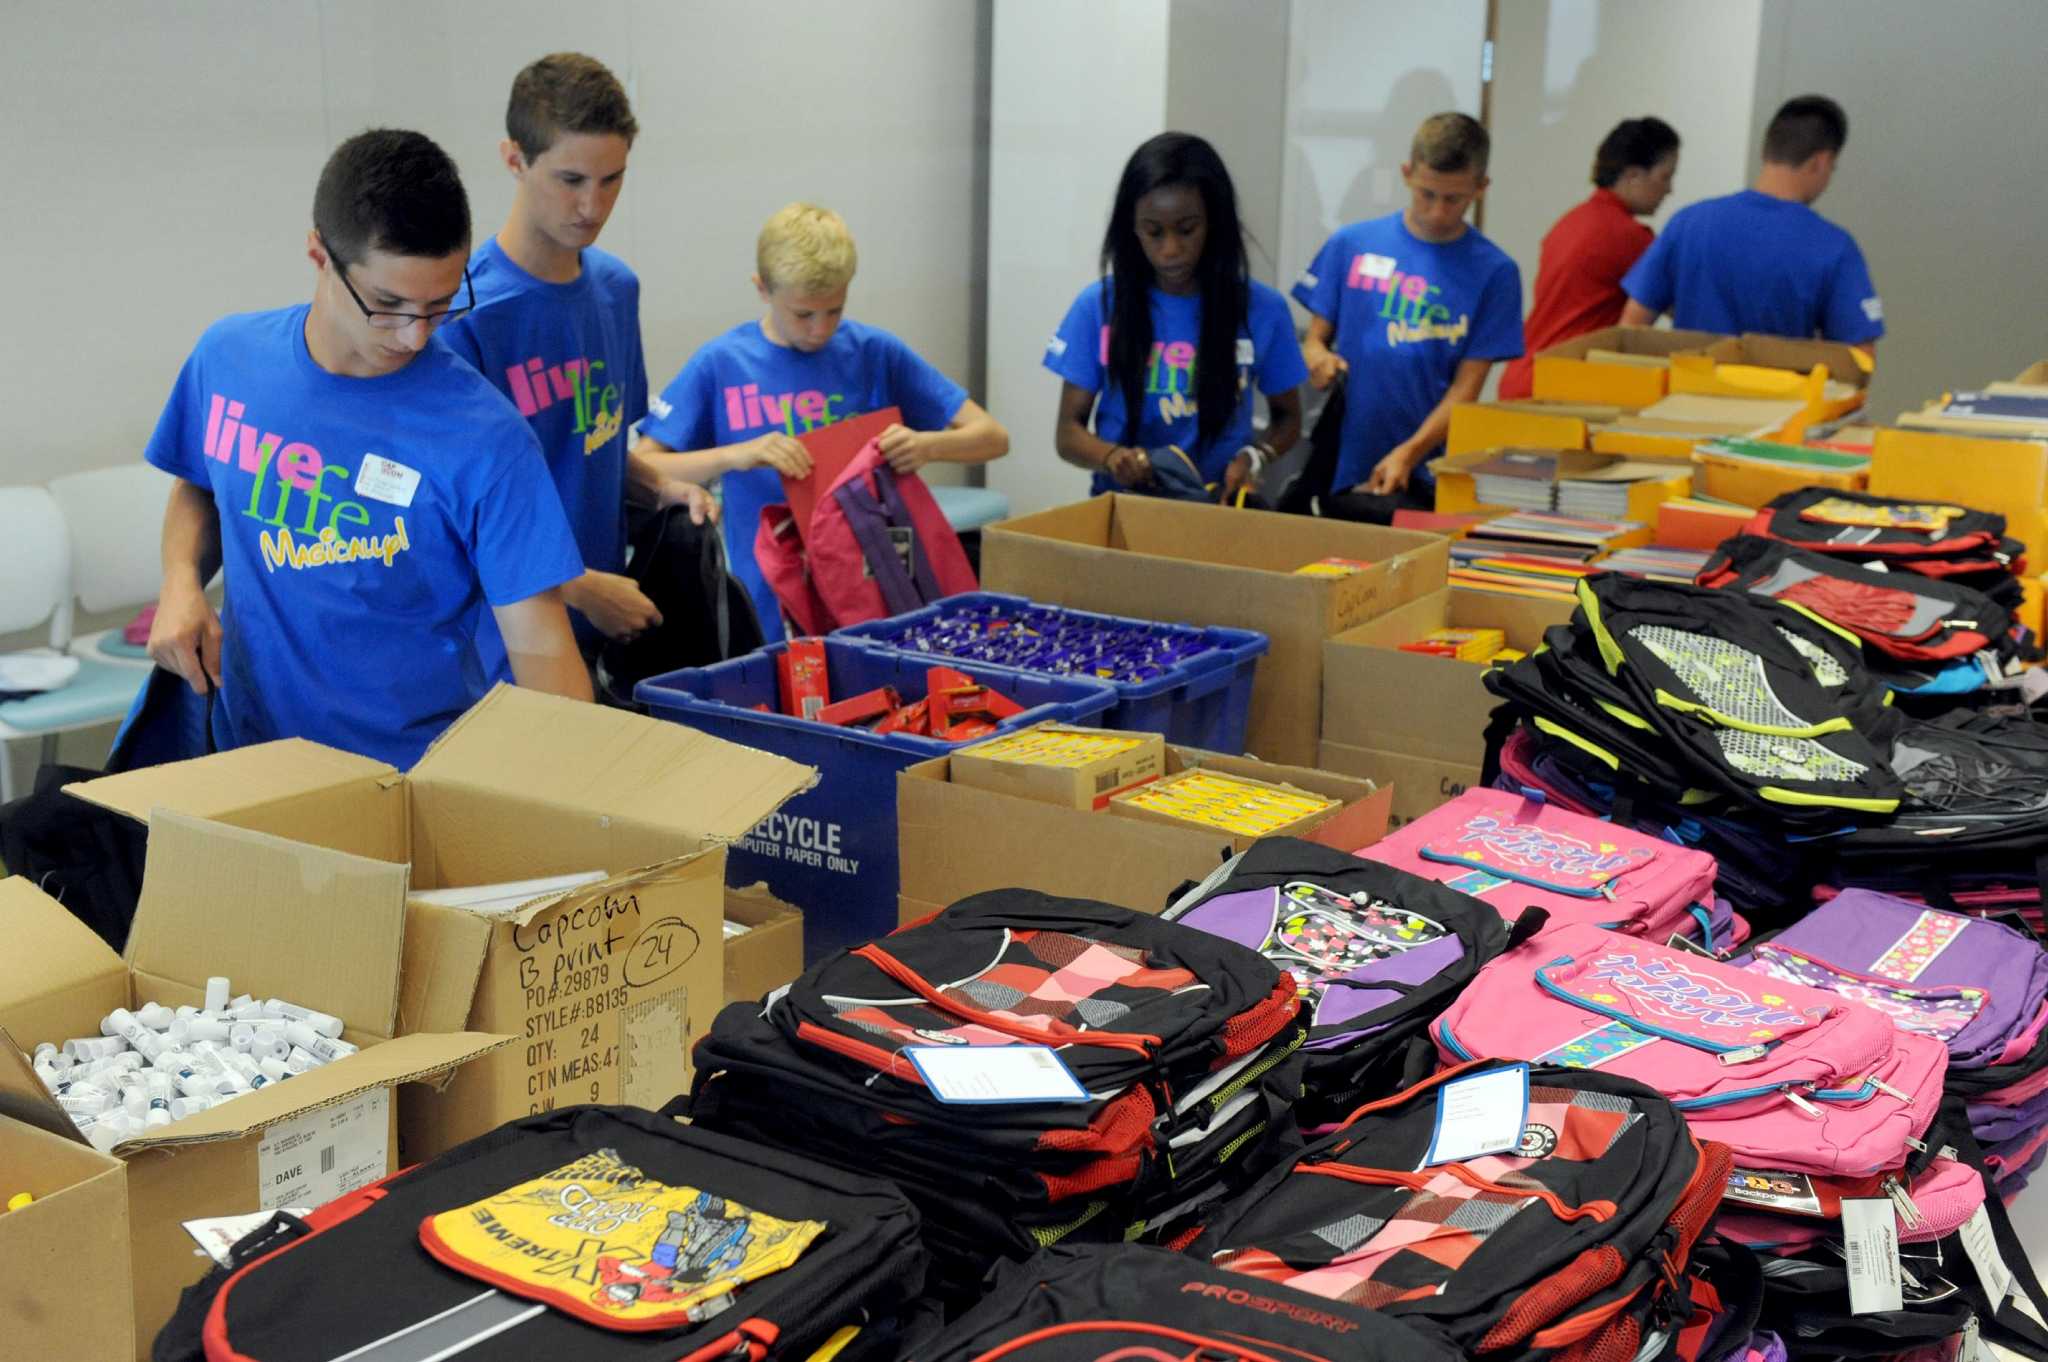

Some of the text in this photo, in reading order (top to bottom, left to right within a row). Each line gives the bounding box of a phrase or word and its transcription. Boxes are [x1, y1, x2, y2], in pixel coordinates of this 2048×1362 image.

[724, 384, 827, 431] live
[204, 393, 324, 490] live
[241, 442, 371, 541] life
[748, 812, 842, 854] ECYCLE
[785, 845, 822, 868] PAPER
[827, 854, 860, 875] ONLY
[553, 928, 625, 992] print
[641, 933, 674, 968] 24
[527, 1023, 600, 1067] QTY: 24
[528, 1066, 557, 1096] CTN
[590, 1081, 600, 1103] 9
[275, 1164, 303, 1185] DAVE
